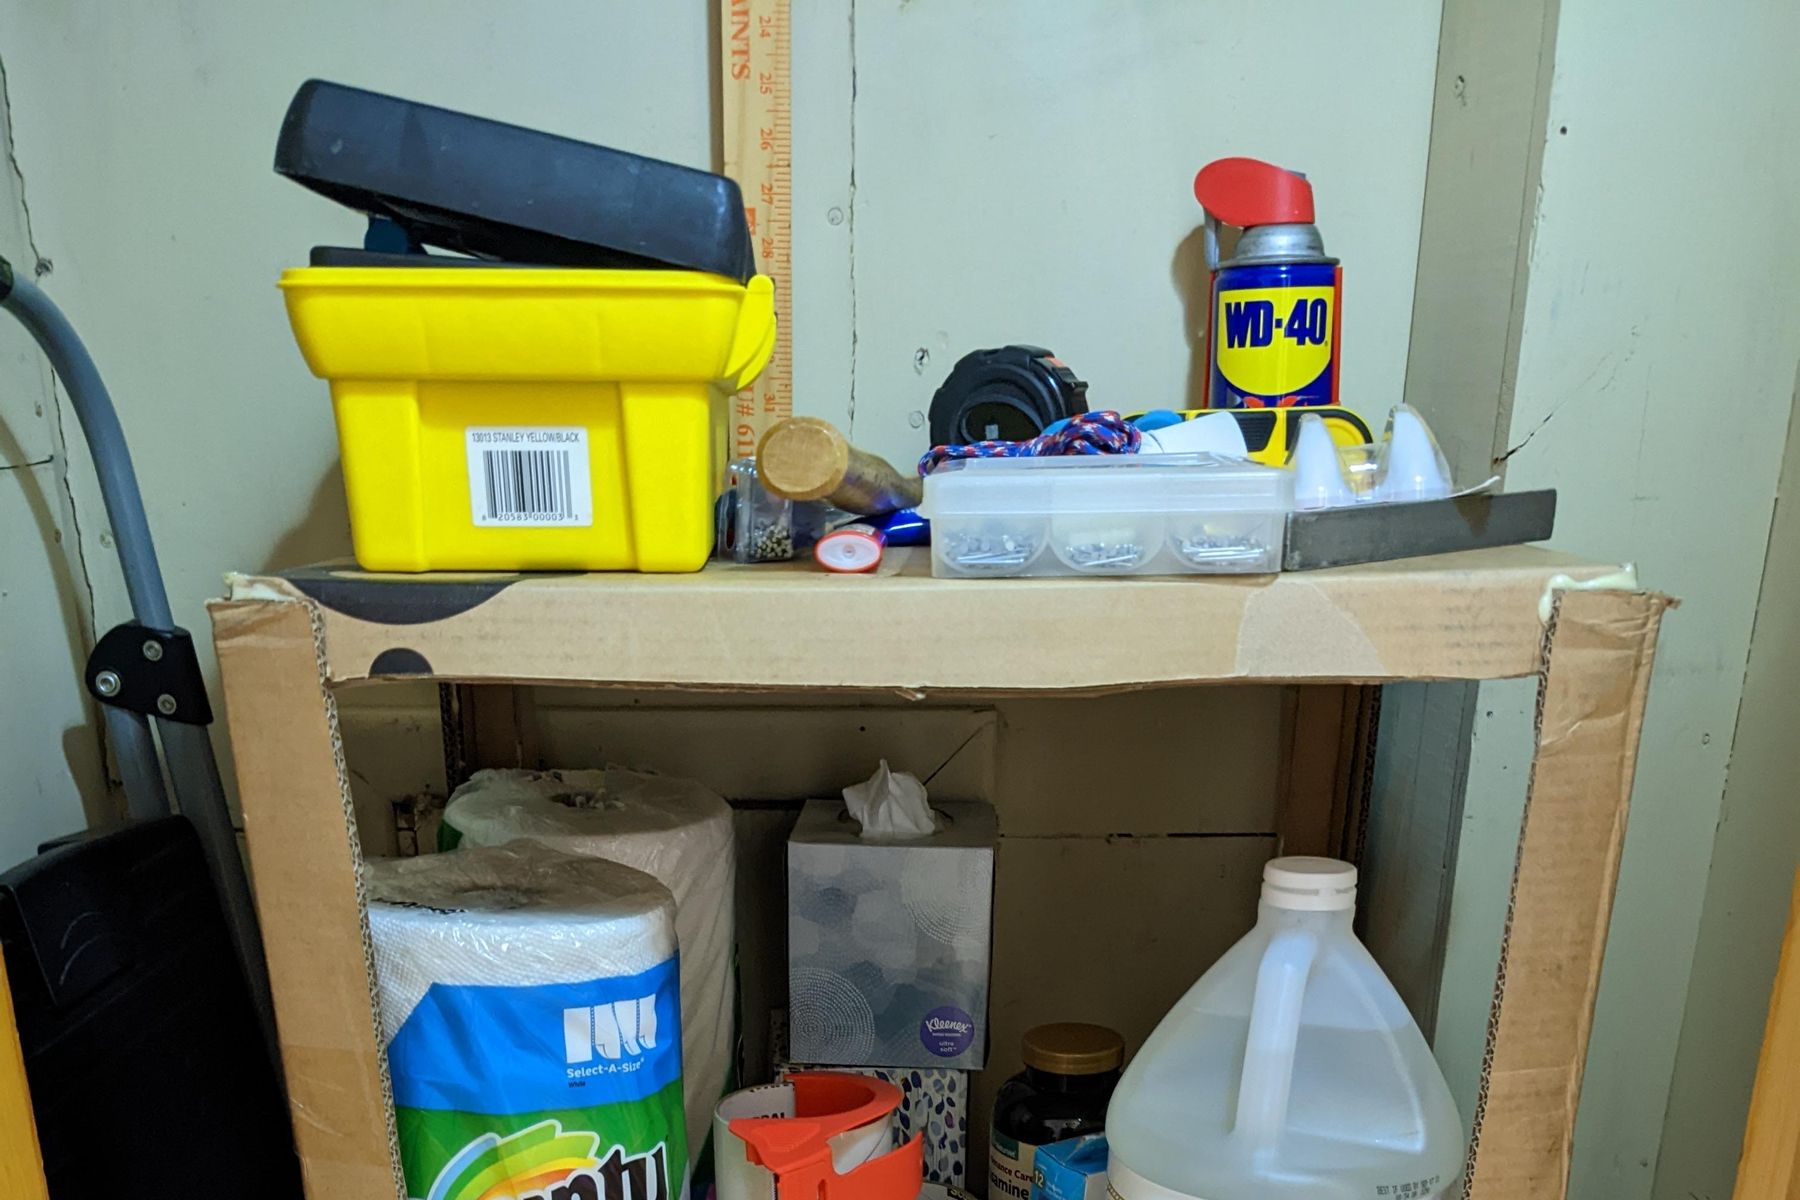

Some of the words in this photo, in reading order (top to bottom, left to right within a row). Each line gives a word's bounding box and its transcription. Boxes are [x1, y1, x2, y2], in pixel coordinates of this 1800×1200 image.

[762, 236, 774, 258] 28
[1224, 298, 1328, 348] WD-40
[472, 432, 493, 443] 13013
[493, 432, 525, 443] STANLEY
[925, 1017, 969, 1033] Kleenex
